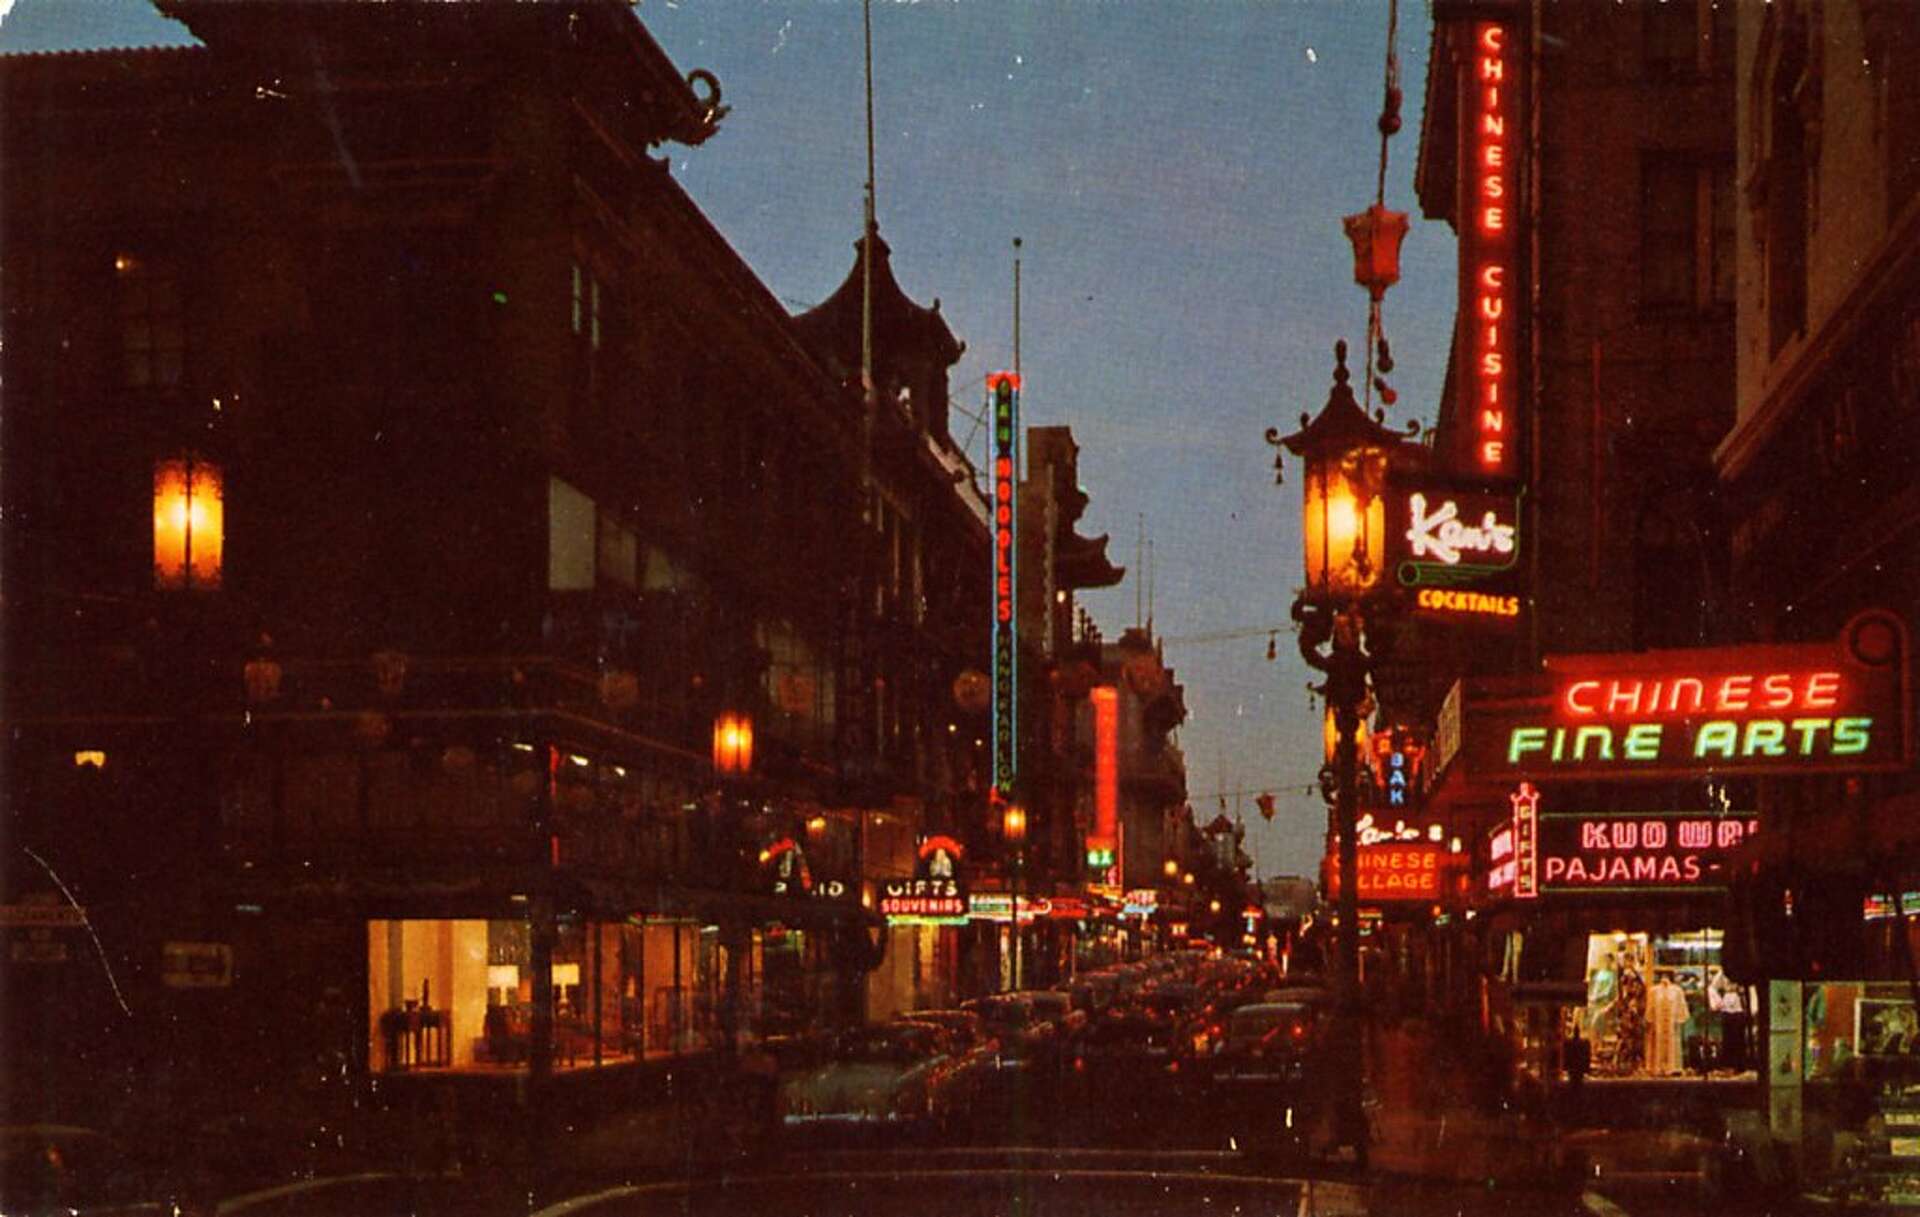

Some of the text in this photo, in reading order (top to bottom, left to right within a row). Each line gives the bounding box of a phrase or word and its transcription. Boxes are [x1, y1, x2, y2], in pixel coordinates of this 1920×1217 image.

[1481, 26, 1503, 463] CHINESE CUISINE
[1404, 491, 1516, 565] Ken's
[1417, 589, 1519, 616] COCKTAILS
[1566, 672, 1841, 715] CHINESE
[1508, 717, 1873, 764] FINE ARTS
[1581, 820, 1668, 849] KUO
[1545, 855, 1701, 882] PAJAMAS
[880, 897, 963, 915] SOUVENIRS
